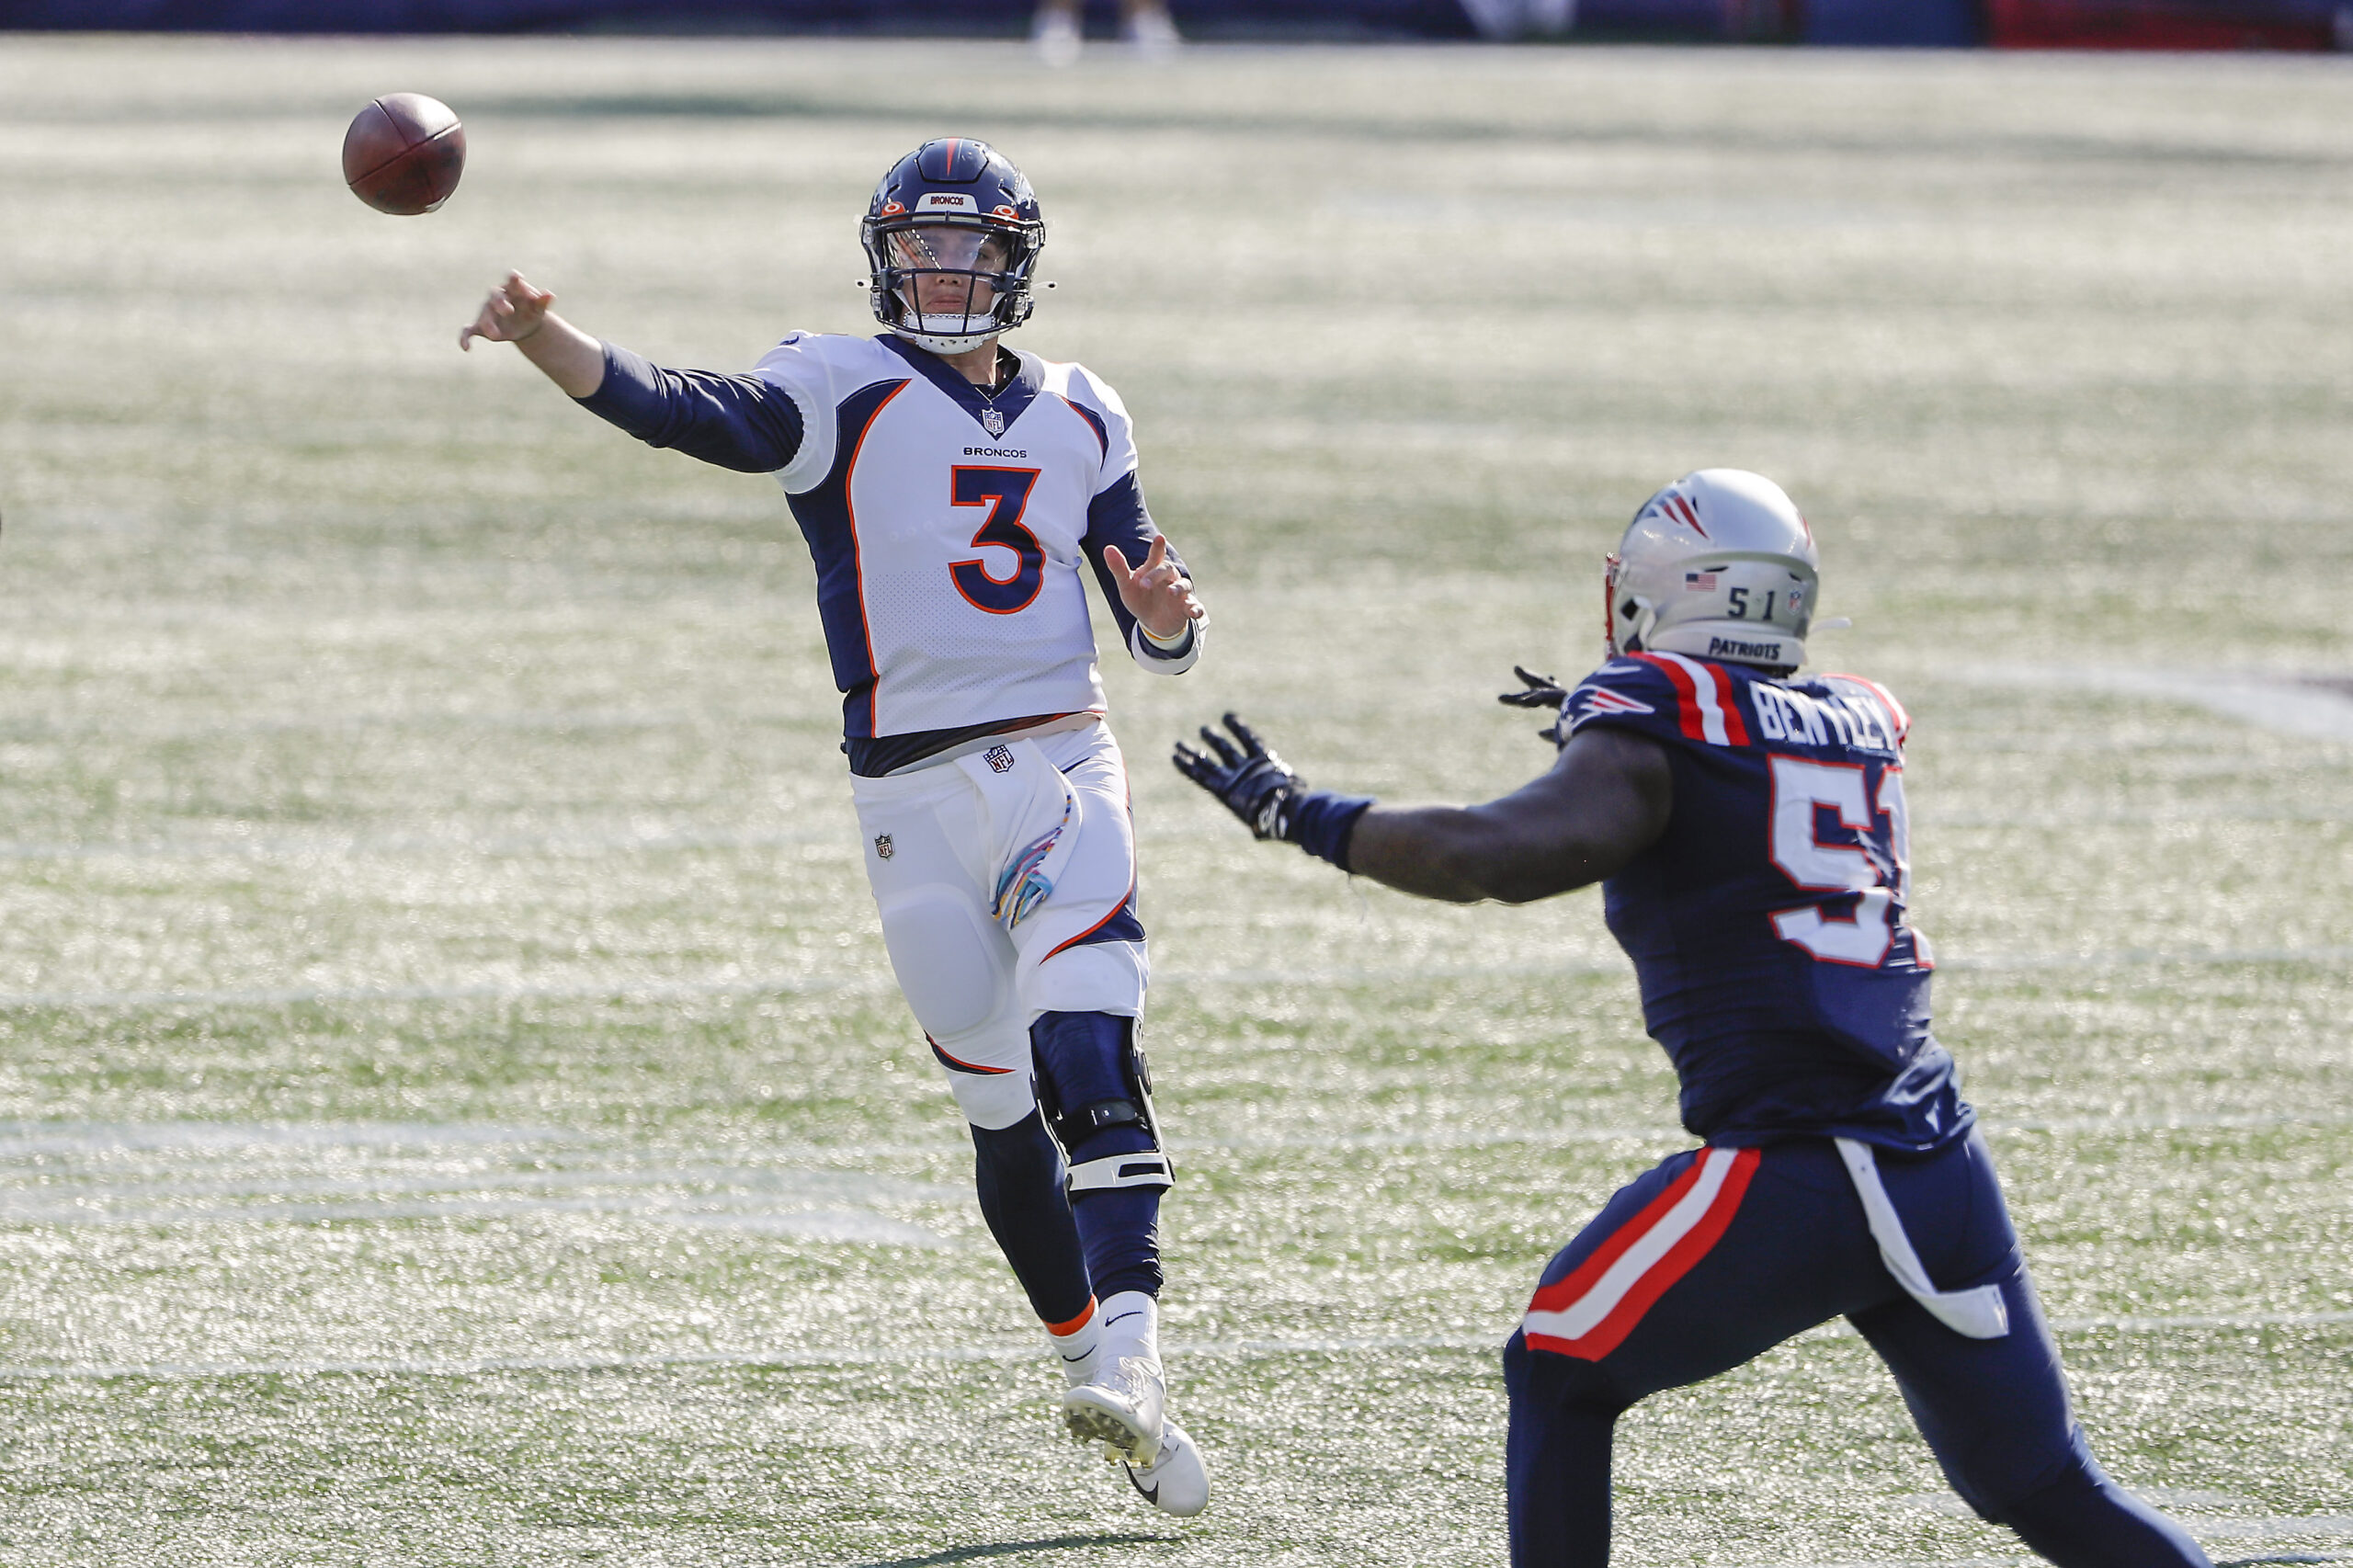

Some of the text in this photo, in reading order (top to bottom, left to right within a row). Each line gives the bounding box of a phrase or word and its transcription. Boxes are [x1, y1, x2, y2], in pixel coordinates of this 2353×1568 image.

[930, 196, 964, 206] BRONCOS
[986, 418, 1002, 431] NFL
[963, 447, 1028, 459] BRONCOS
[949, 464, 1046, 615] 3
[1727, 586, 1777, 621] 51
[1708, 636, 1781, 661] PATRIOTS
[990, 753, 1013, 771] NFL
[878, 843, 893, 857] NFL
